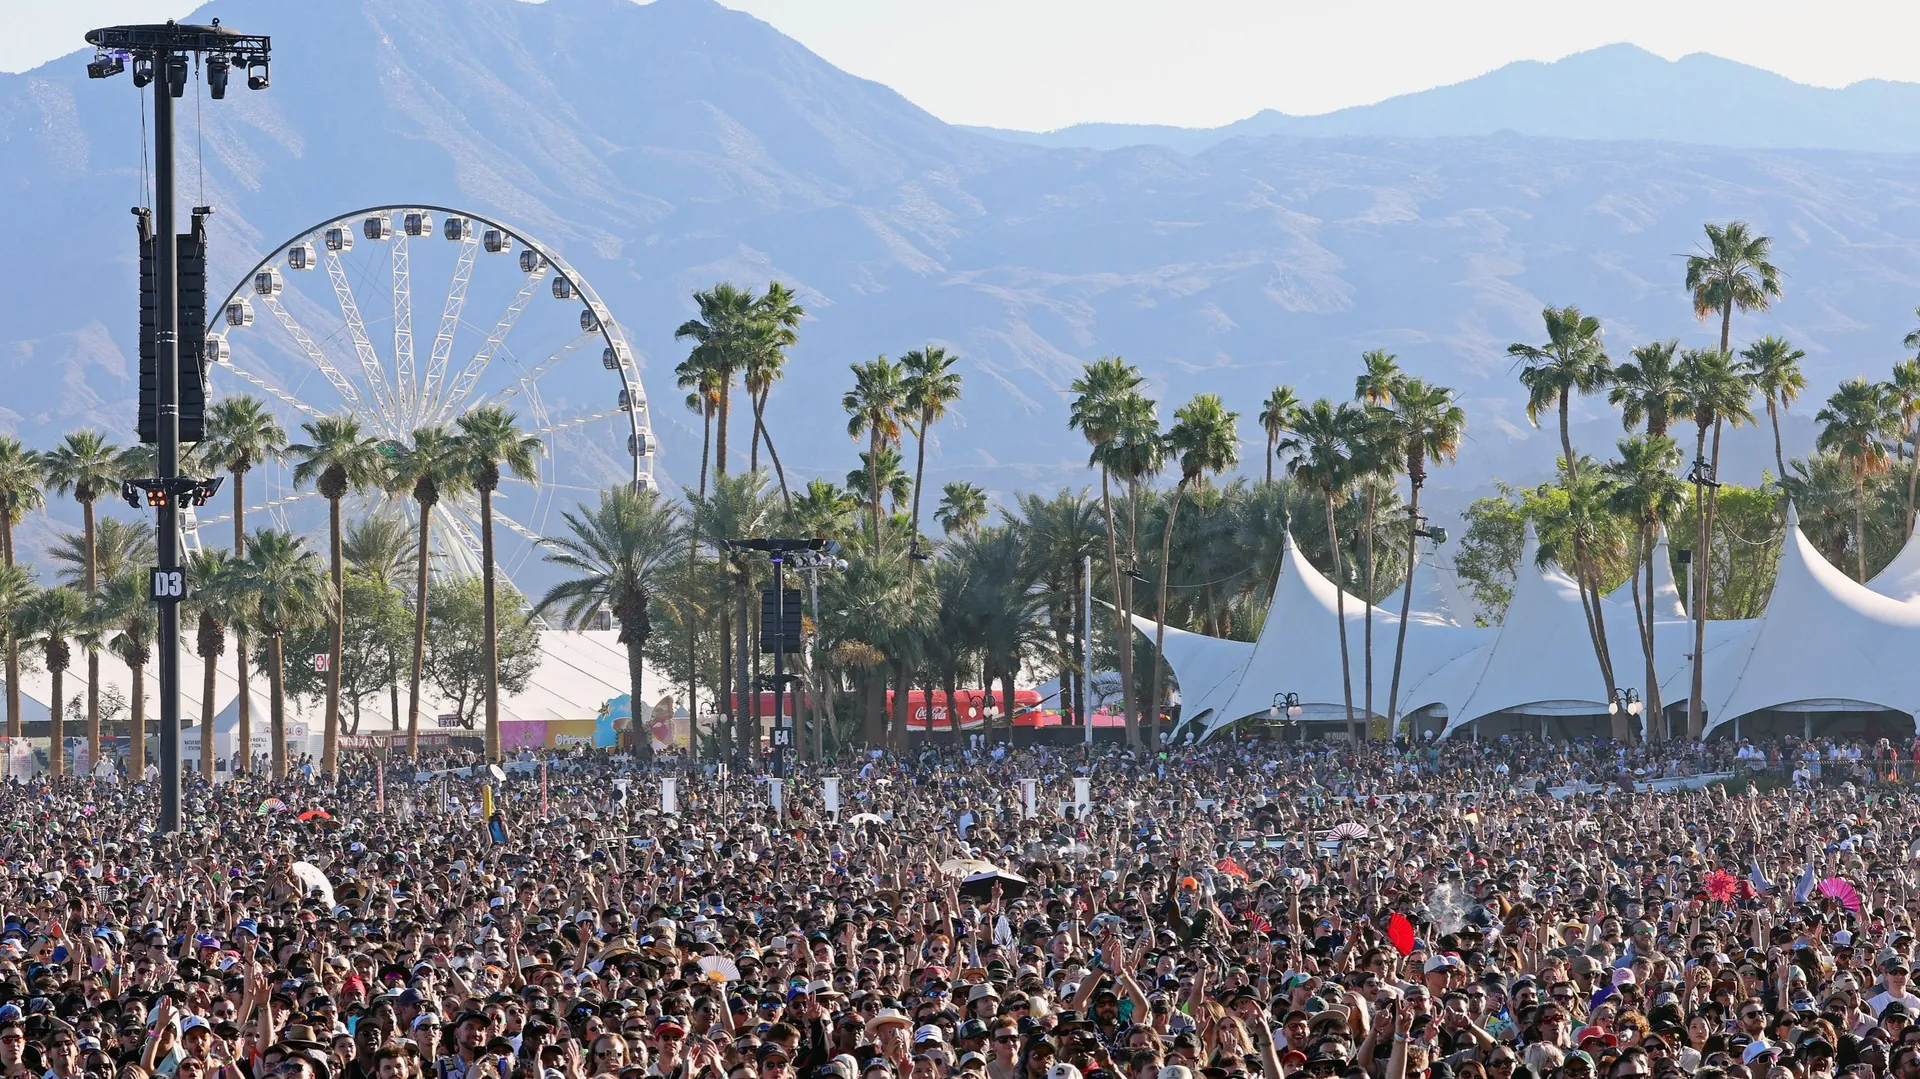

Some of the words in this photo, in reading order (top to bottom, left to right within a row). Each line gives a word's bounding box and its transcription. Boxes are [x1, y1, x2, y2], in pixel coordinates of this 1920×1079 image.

[155, 571, 182, 597] D3
[394, 736, 432, 747] EMENCY
[434, 736, 448, 745] EXIT
[562, 734, 592, 746] Pinterest
[774, 730, 788, 745] E4
